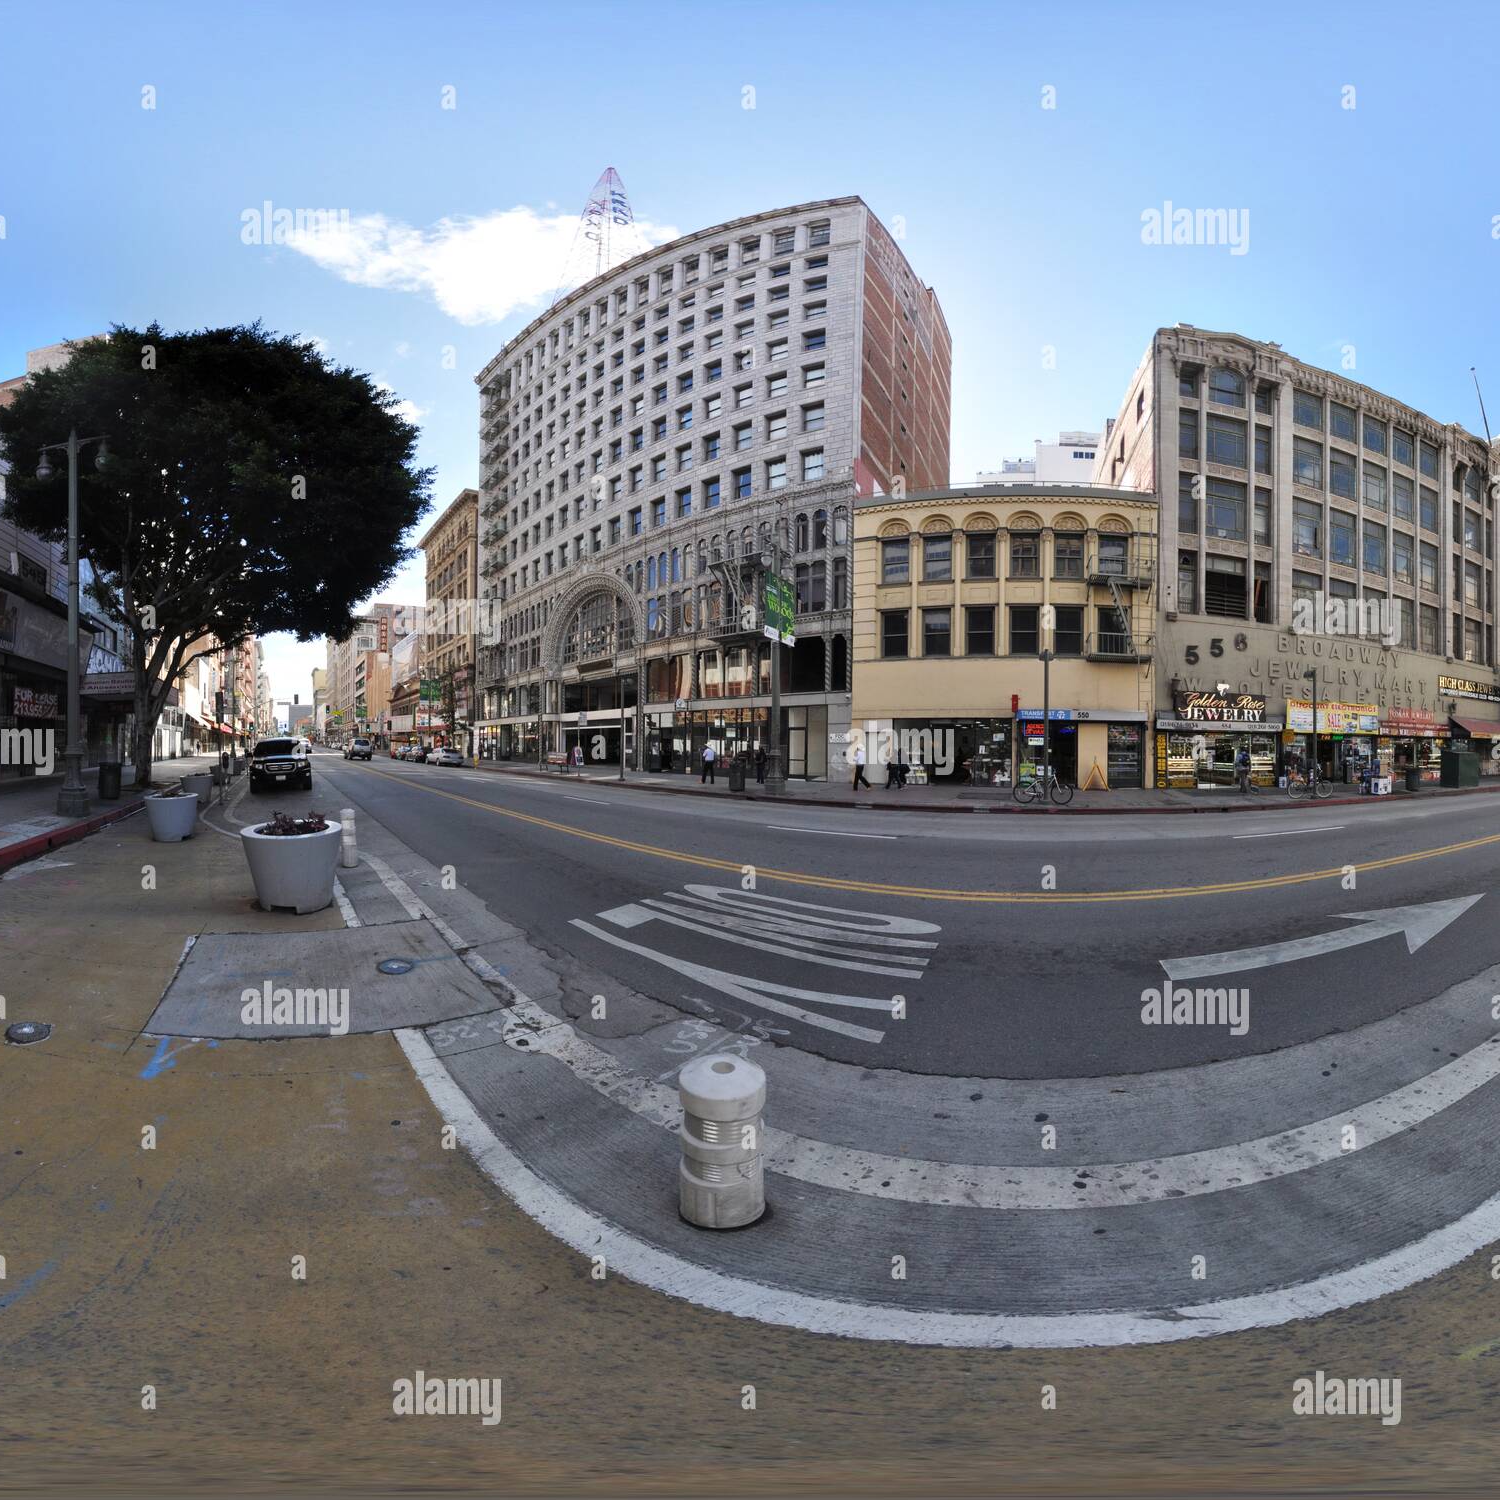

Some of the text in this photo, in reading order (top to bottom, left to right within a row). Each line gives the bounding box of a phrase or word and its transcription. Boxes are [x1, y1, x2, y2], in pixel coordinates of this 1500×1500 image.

[1185, 633, 1248, 666] 556
[1277, 633, 1400, 668] BROADWAY
[1374, 672, 1427, 696] MART
[1439, 676, 1457, 689] HIGH
[1457, 679, 1476, 692] CLASS
[14, 687, 58, 705] FOR LEASE
[1178, 692, 1265, 711] Golden Rose
[1180, 708, 1263, 721] JEWELRY
[1290, 701, 1376, 713] DISCOUNT ELECTRONICS
